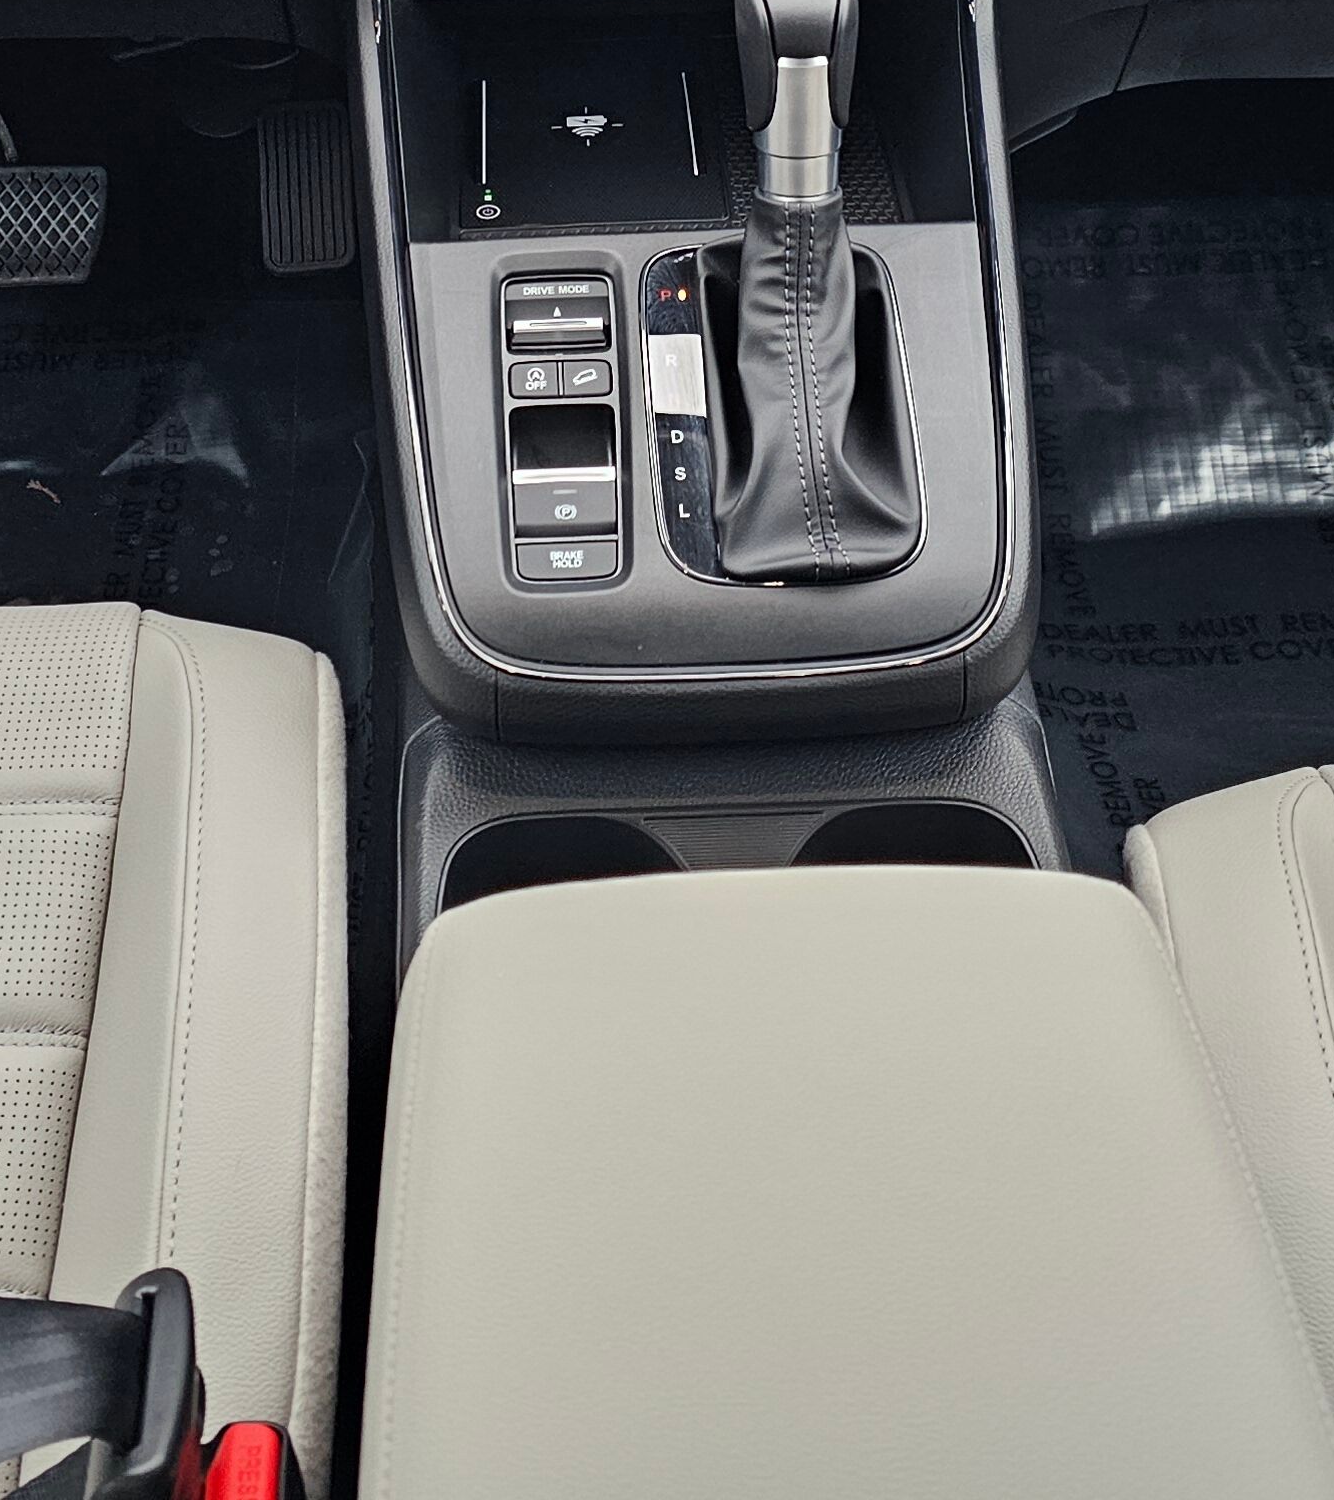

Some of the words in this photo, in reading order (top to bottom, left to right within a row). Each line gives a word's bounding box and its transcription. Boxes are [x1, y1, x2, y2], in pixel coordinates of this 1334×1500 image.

[523, 285, 555, 296] DRIVE
[558, 284, 590, 294] MODE
[660, 290, 672, 300] P
[525, 380, 547, 391] OFF
[671, 429, 684, 444] D
[675, 466, 686, 481] S
[679, 503, 690, 518] L
[550, 550, 584, 561] BRAKE
[552, 559, 583, 569] HOLD
[1039, 622, 1157, 643] DEALER
[1178, 613, 1263, 640] MUST
[1045, 643, 1242, 666] PROTECTIVE
